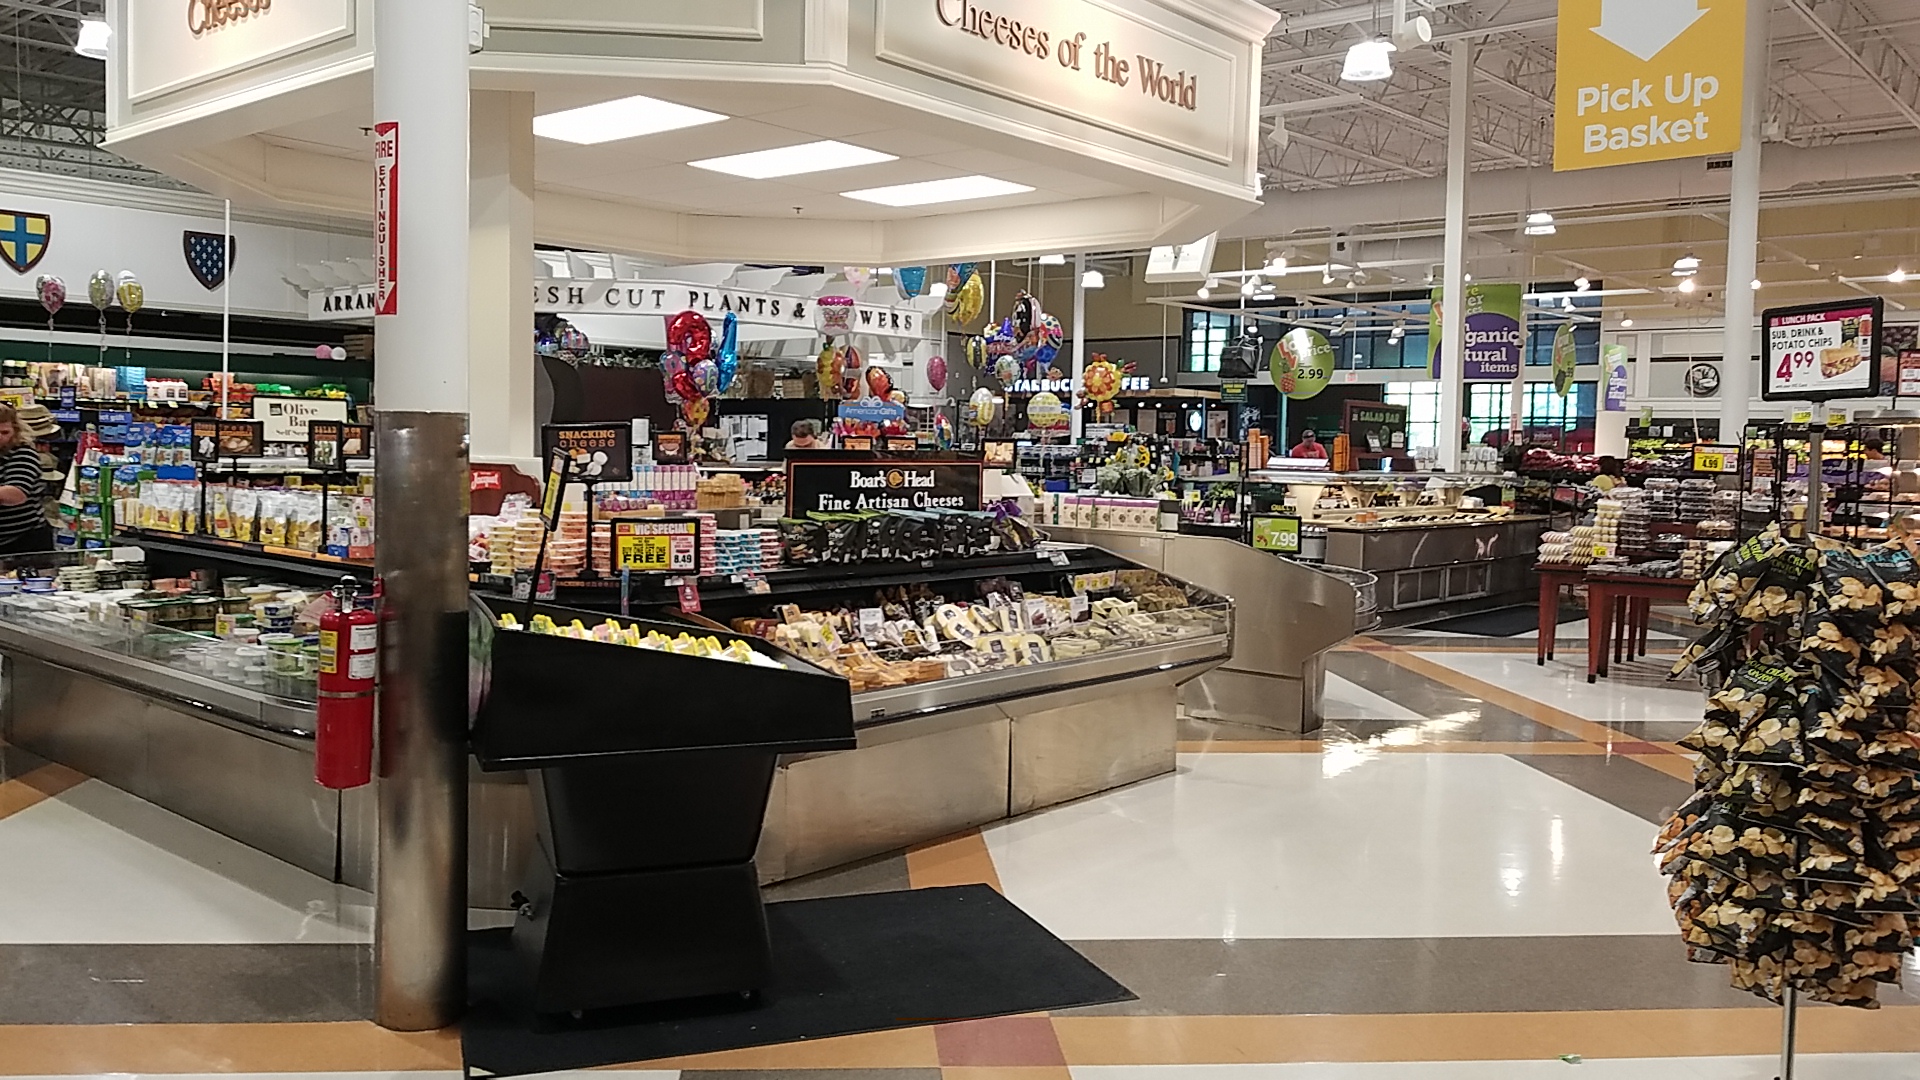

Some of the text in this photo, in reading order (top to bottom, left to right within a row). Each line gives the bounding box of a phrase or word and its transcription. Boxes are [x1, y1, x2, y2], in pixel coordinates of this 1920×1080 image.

[935, 0, 1198, 111] Cheeses of the World
[1577, 73, 1719, 116] Pick Up
[1583, 112, 1709, 153] Basket
[375, 141, 393, 159] FIRE
[378, 165, 386, 300] EXTINGUISHER
[605, 288, 665, 306] CUT
[688, 291, 780, 315] PLANTS
[793, 302, 805, 318] &
[859, 310, 913, 330] WERS
[1790, 326, 1817, 338] DRINK
[1771, 337, 1833, 351] POTATO CHIPS
[1297, 368, 1323, 379] 2.99
[1480, 362, 1518, 373] items
[1121, 376, 1150, 390] FEE
[283, 403, 318, 415] Olive
[1360, 411, 1384, 422] SALAD
[1385, 413, 1400, 424] BAR
[558, 430, 616, 439] SNACKING
[559, 438, 616, 448] cheese
[850, 470, 935, 488] Boar's Head
[818, 489, 964, 511] Fine Artisan Cheeses
[634, 523, 651, 535] VIC
[652, 523, 690, 535] SPECIAL
[1270, 531, 1298, 547] 7.99
[623, 554, 666, 563] FREE
[674, 554, 692, 563] 8.49
